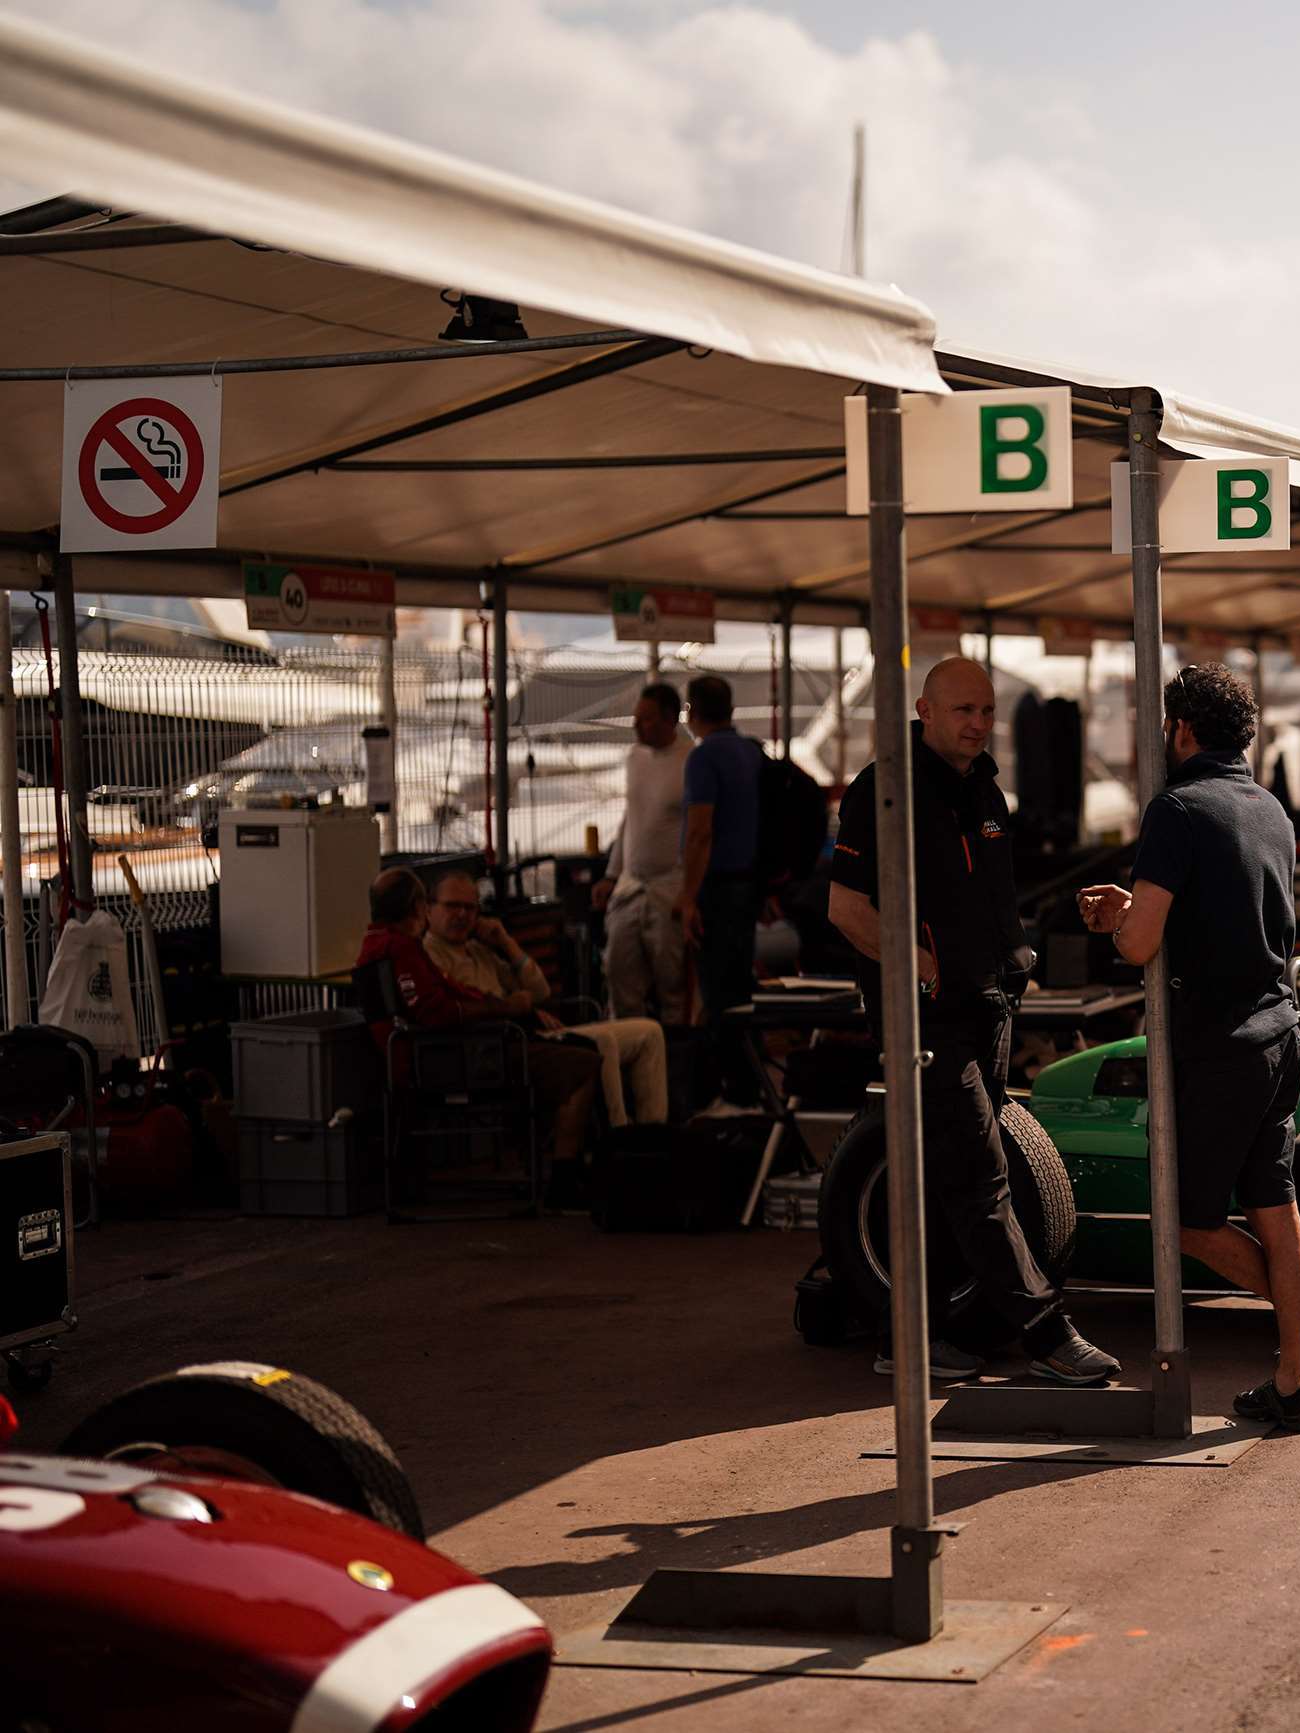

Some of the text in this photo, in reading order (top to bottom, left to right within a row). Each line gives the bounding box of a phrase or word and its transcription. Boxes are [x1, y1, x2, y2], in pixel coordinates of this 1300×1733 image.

[980, 404, 1048, 493] B
[1217, 469, 1271, 540] B
[285, 587, 304, 609] 40
